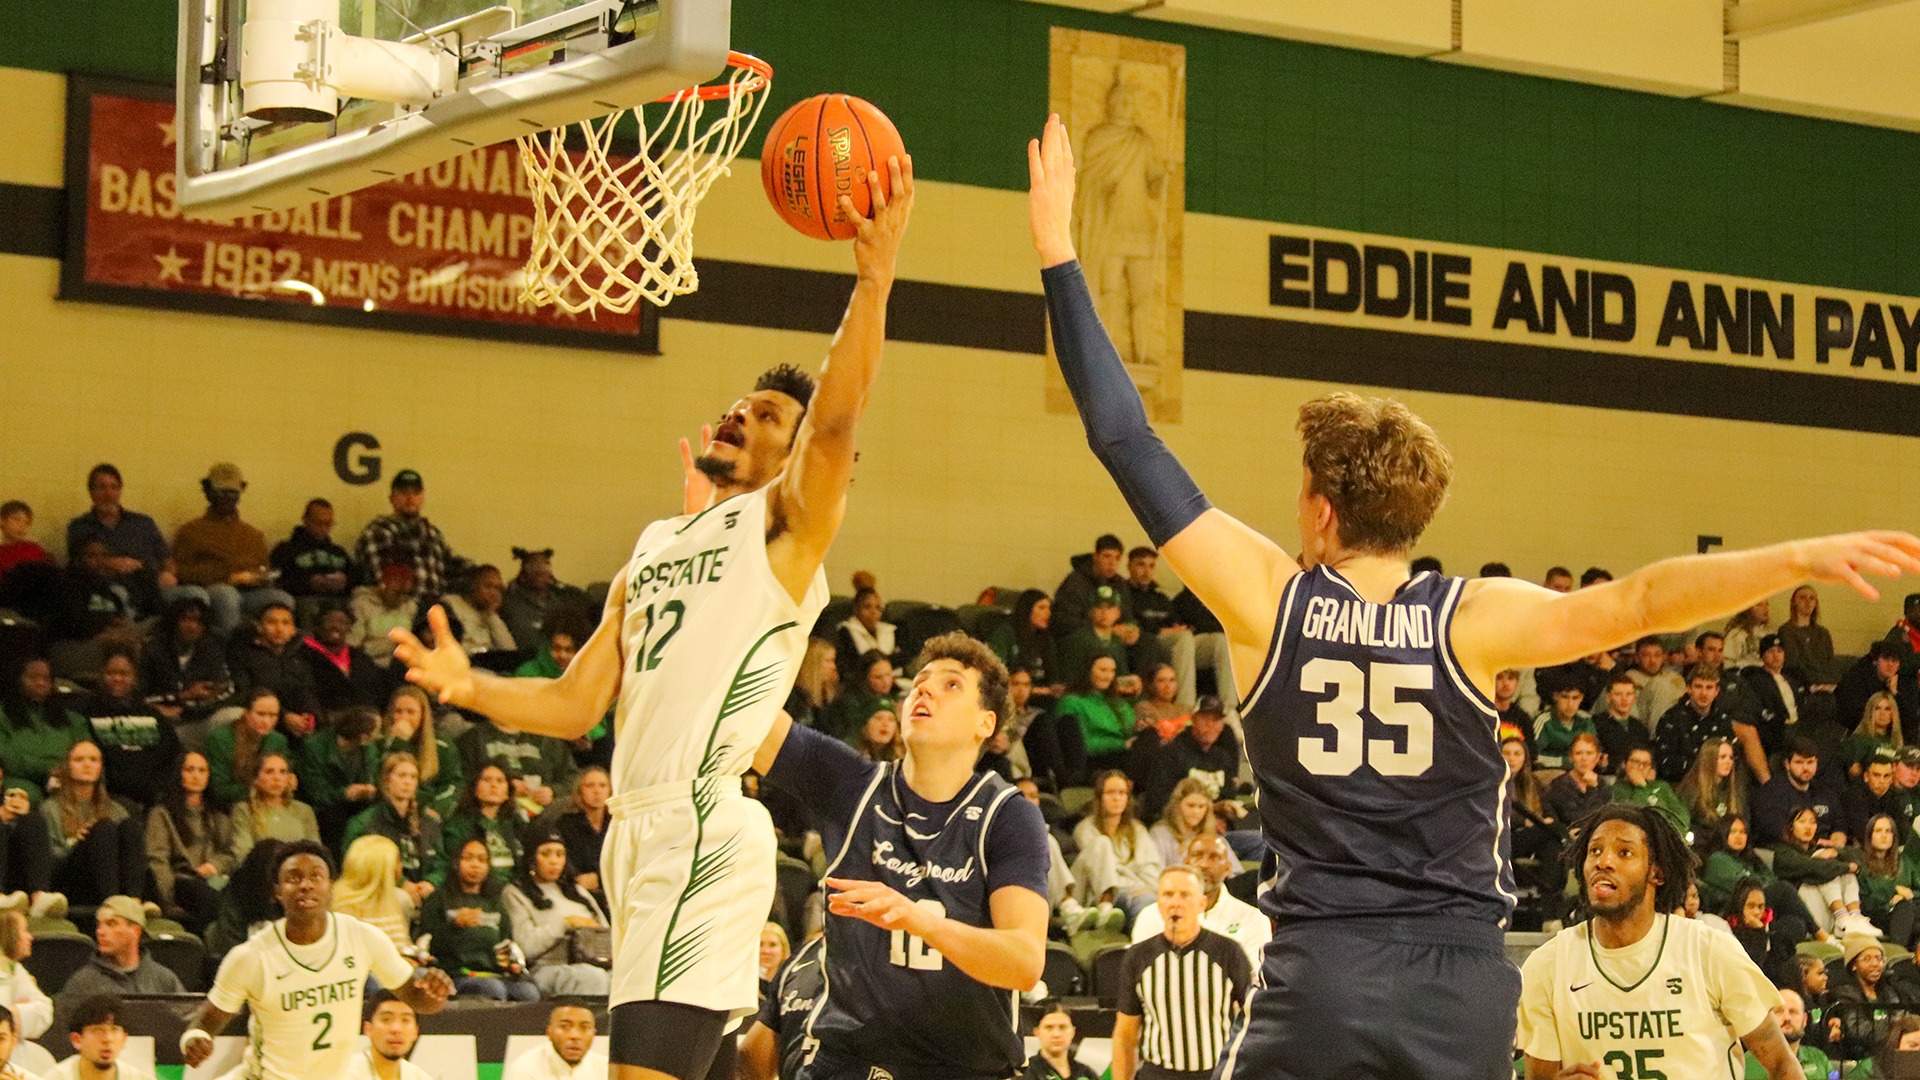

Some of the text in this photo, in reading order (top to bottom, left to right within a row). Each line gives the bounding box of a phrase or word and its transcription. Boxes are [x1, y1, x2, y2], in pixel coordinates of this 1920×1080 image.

[793, 135, 812, 219] LEGACY
[1269, 235, 1472, 326] EDDIE
[1493, 262, 1636, 342] AND
[1656, 280, 1795, 360] ANN
[334, 431, 382, 486] G
[636, 600, 686, 673] 12
[1302, 596, 1434, 648] GRANLUND
[1298, 657, 1434, 776] 35
[281, 979, 357, 1012] UPSTATE
[312, 1012, 333, 1051] 2
[1578, 1009, 1684, 1040] UPSTATE
[1603, 1049, 1668, 1080] 35
